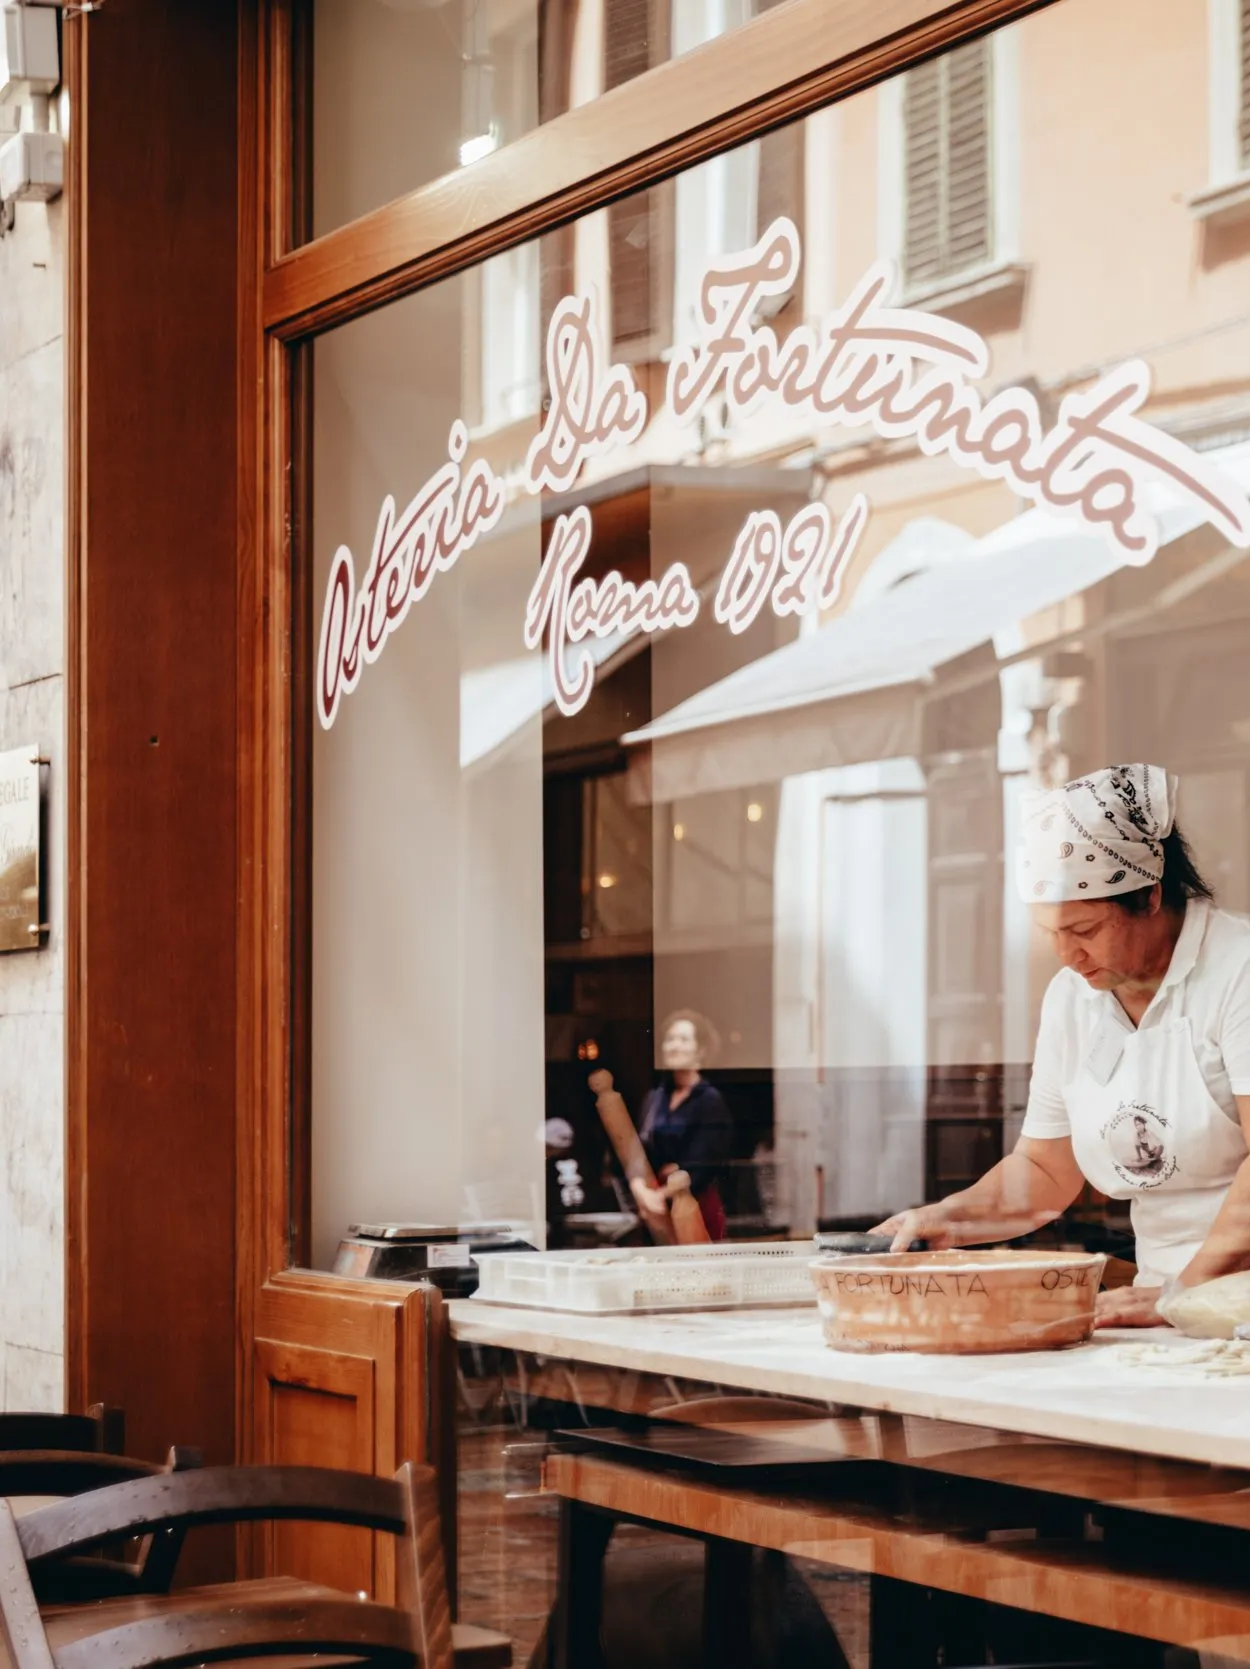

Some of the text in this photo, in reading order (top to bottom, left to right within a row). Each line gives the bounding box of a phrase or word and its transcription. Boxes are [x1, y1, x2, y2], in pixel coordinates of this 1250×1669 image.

[318, 420, 504, 729] Osteria
[525, 493, 867, 716] Roma 1921
[834, 1272, 989, 1298] FORTUNATA
[1041, 1265, 1099, 1291] OSTE
